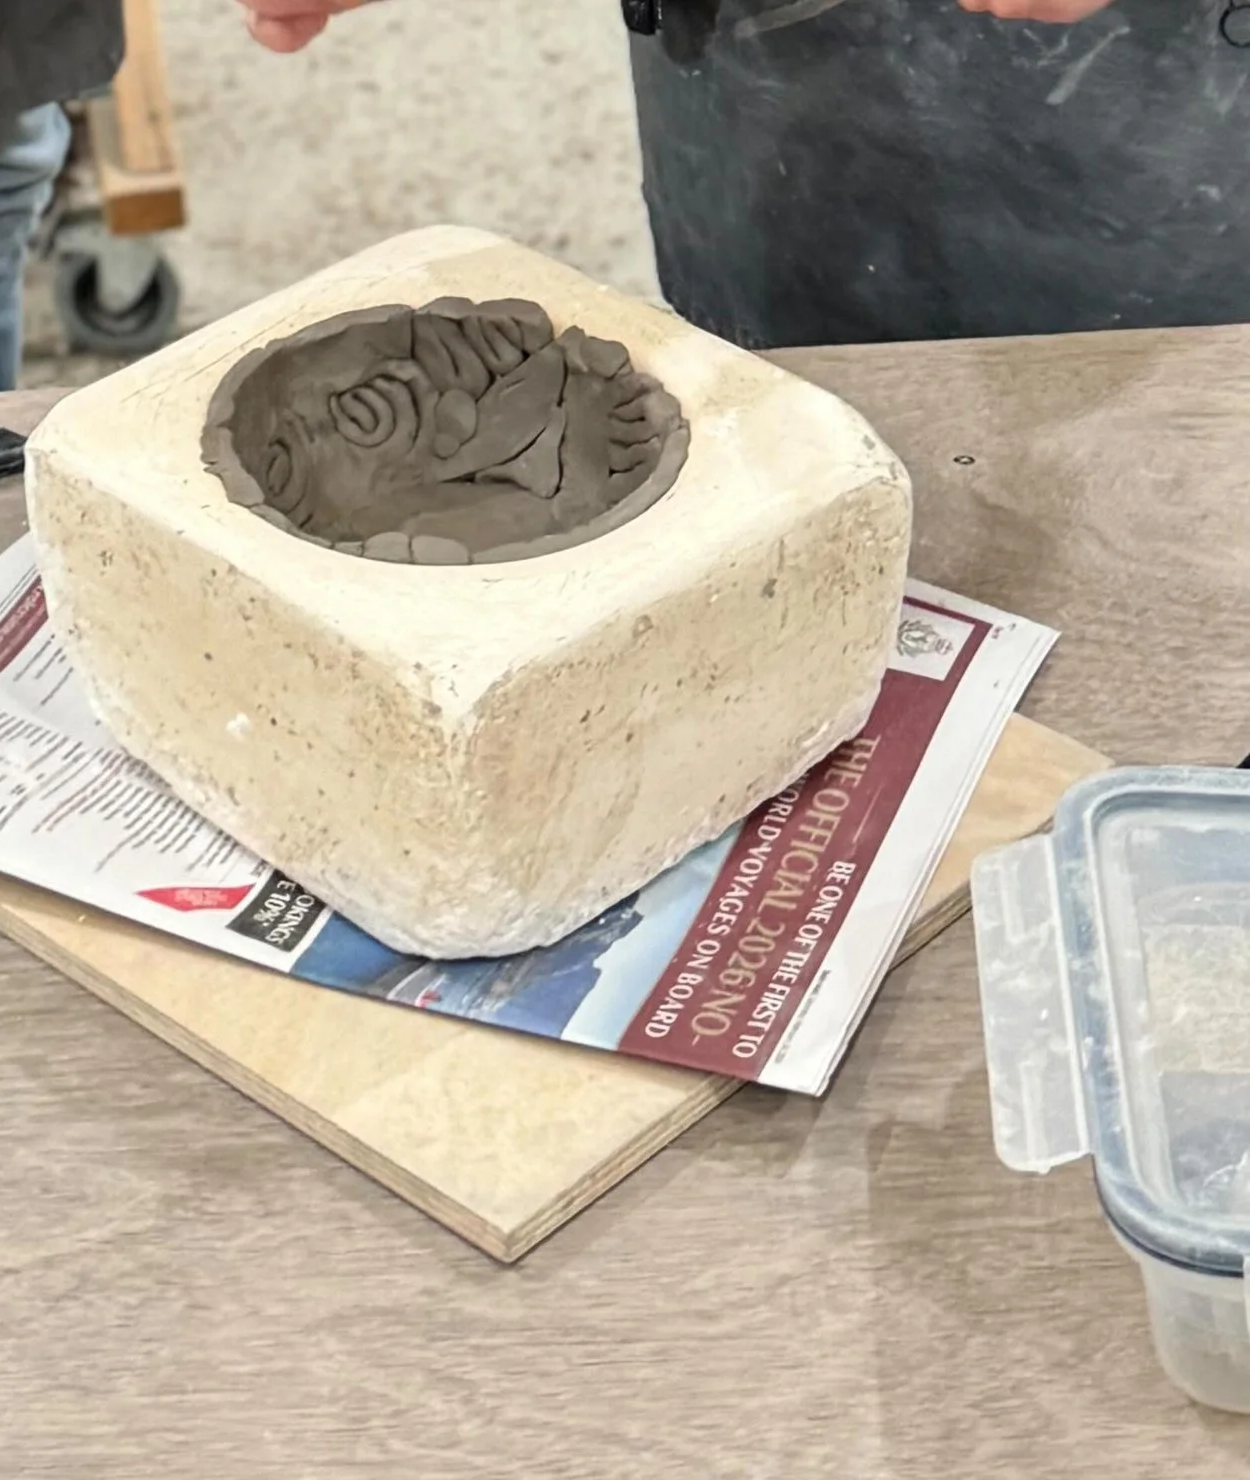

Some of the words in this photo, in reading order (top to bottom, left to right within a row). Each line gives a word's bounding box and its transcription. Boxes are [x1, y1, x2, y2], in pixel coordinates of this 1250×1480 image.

[824, 734, 881, 788] THE
[757, 789, 849, 914] OFFICIAL
[824, 860, 857, 886] BE
[707, 846, 772, 936] VOYAGES
[805, 886, 843, 925] ONE
[687, 940, 721, 970] ON
[718, 916, 785, 988] 2026
[794, 924, 823, 953] OF
[772, 951, 811, 984] THE
[645, 972, 704, 1038] BOARD
[747, 983, 791, 1032] FIRST
[732, 1034, 764, 1058] TO
